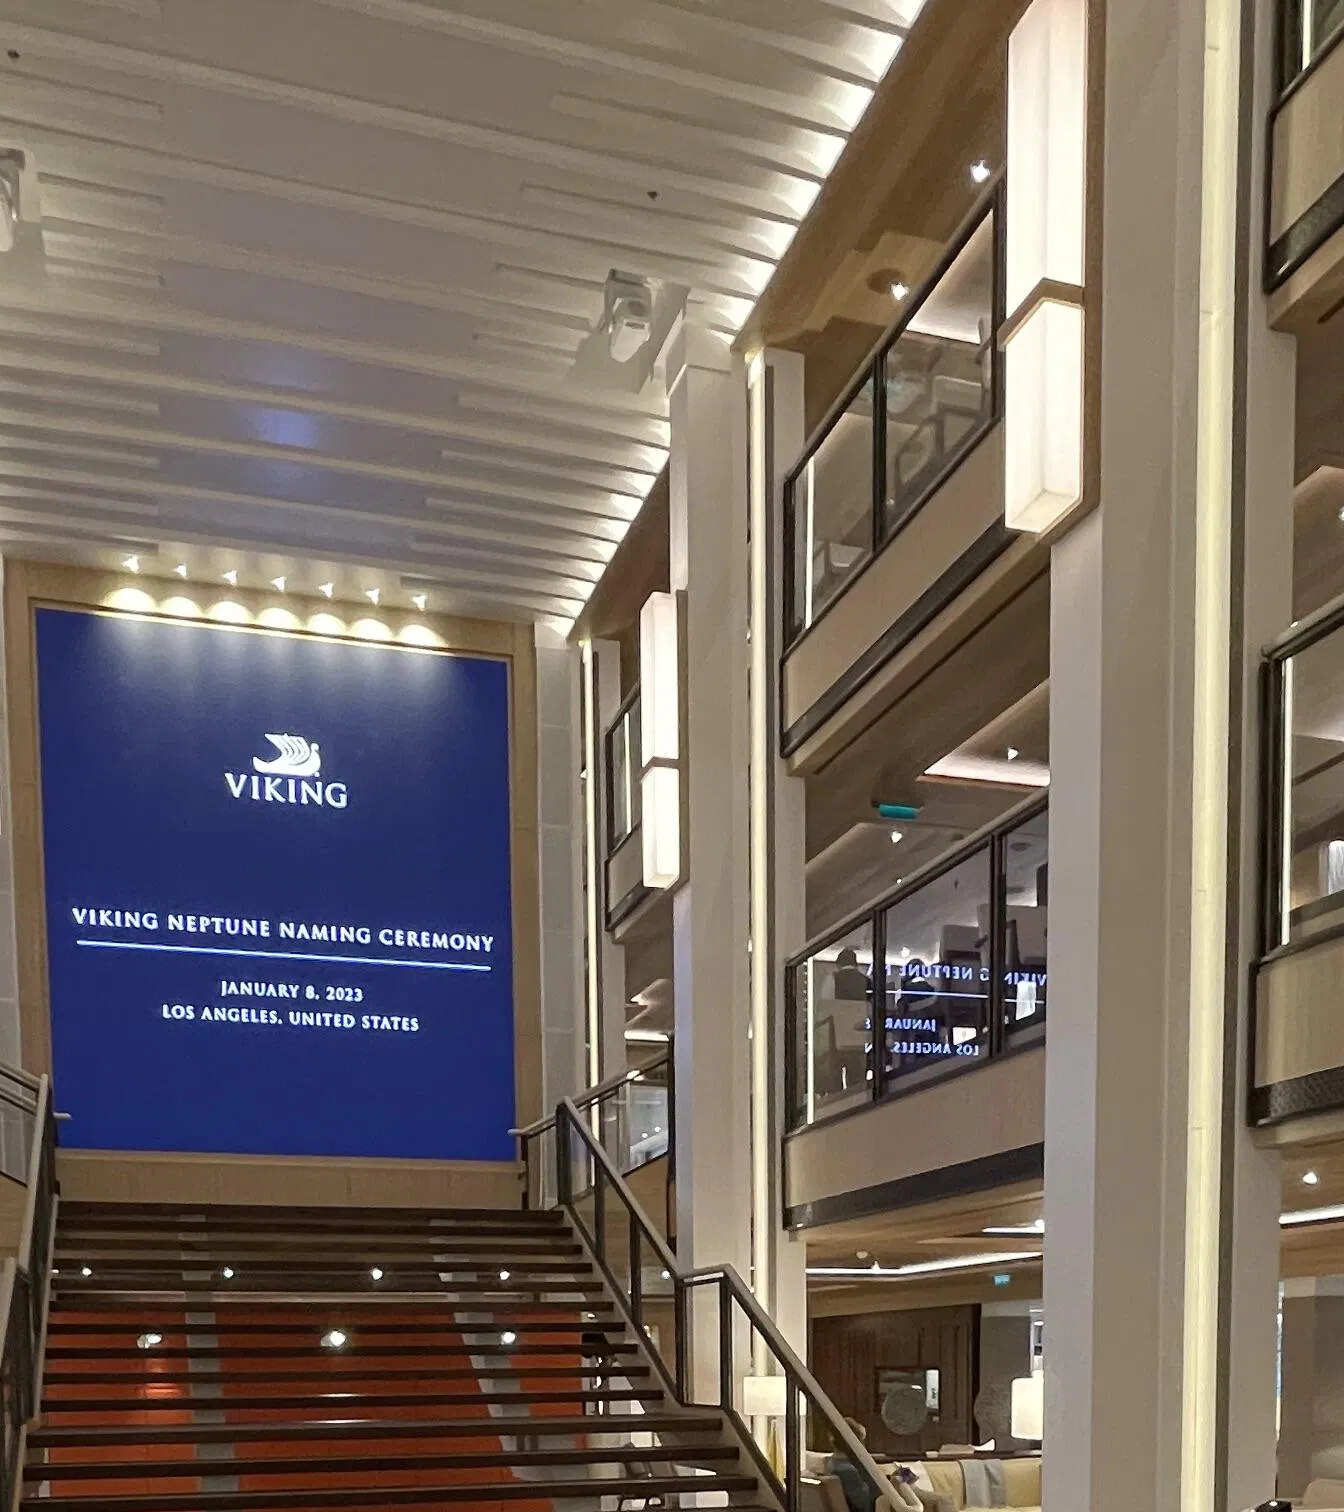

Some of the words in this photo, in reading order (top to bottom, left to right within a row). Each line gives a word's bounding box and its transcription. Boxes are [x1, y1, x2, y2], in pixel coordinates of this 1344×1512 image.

[224, 772, 348, 809] VIKING
[71, 907, 159, 930] VIKING
[167, 914, 270, 938] NEPTUNE
[279, 922, 371, 944] NAMING
[378, 928, 494, 953] CEREMONY
[221, 980, 300, 999] JANUARY
[325, 986, 364, 1002] 2023
[162, 1004, 195, 1020] LOS
[288, 1011, 356, 1028] UNITED
[361, 1015, 420, 1032] STATES
